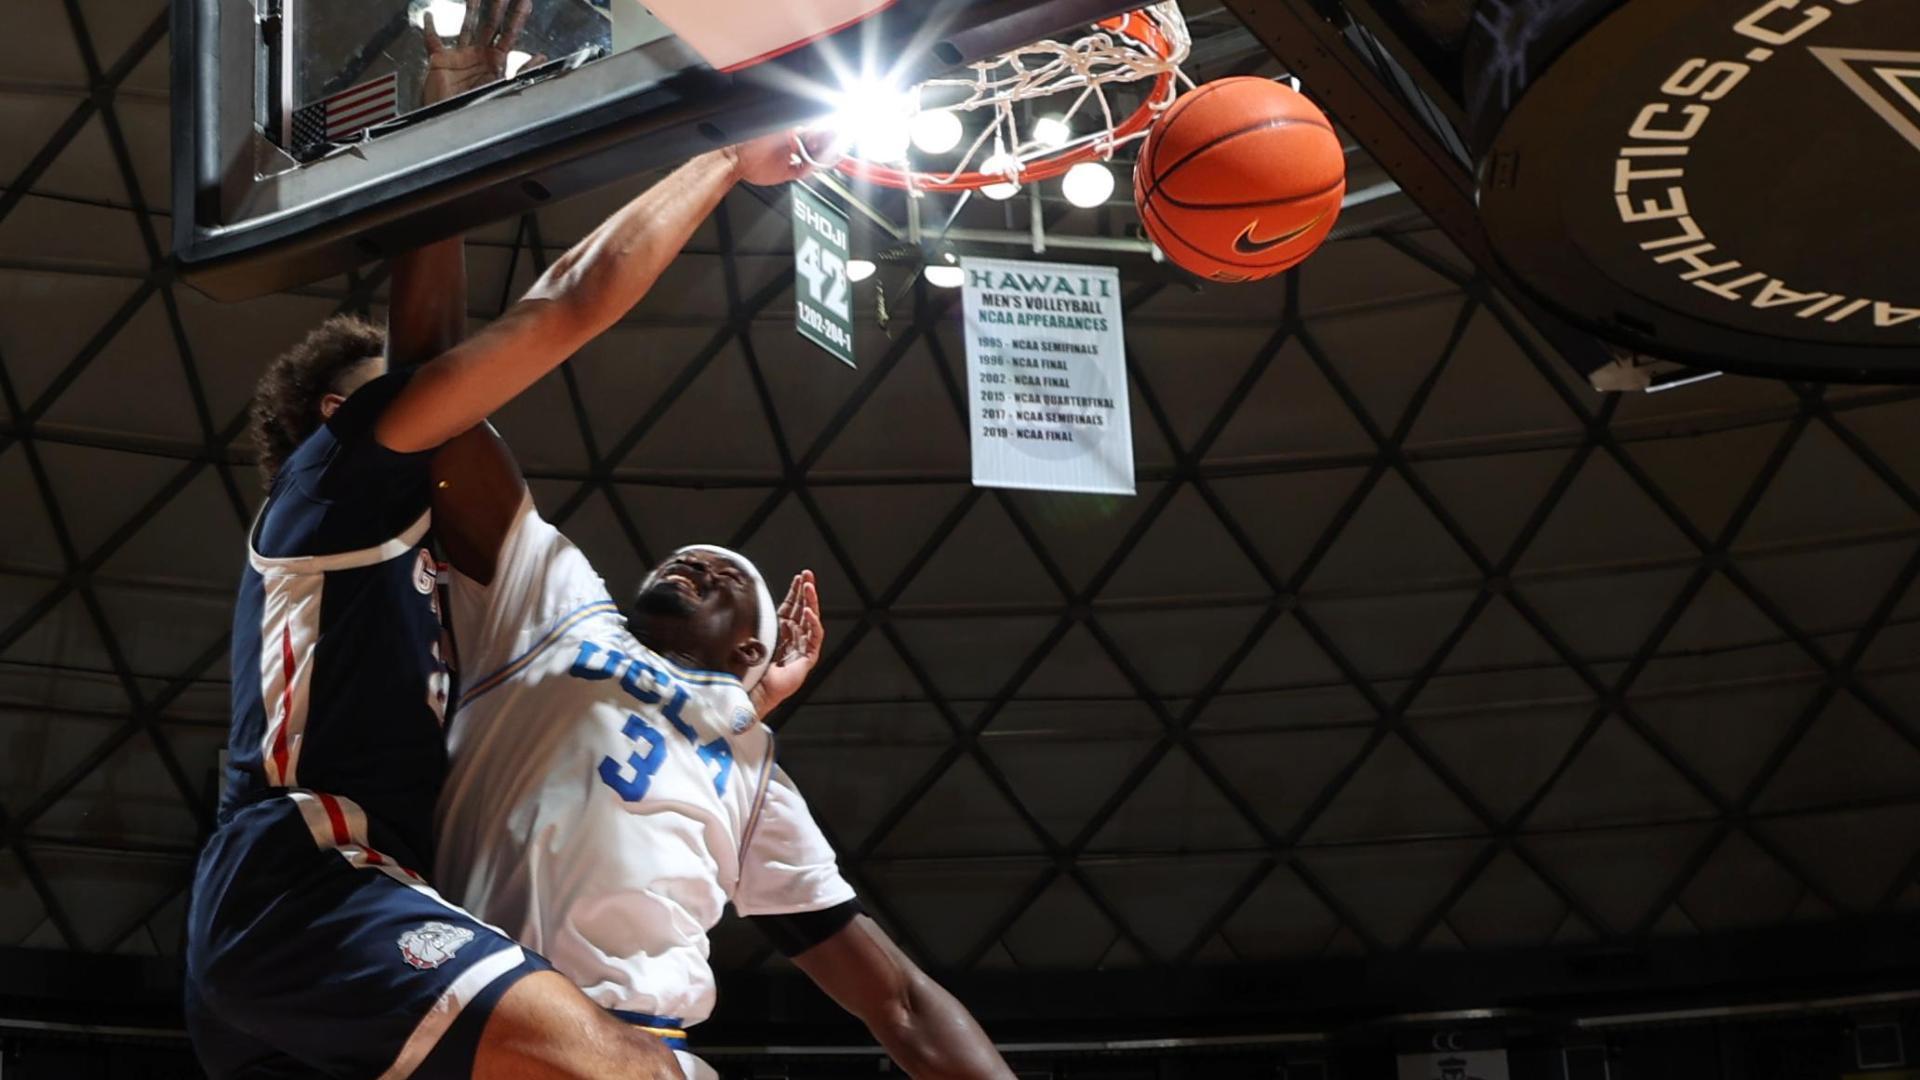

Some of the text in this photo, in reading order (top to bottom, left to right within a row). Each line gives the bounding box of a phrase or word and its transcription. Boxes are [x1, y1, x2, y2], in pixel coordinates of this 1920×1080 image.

[1615, 0, 1920, 326] AIIATHLETICS.C
[793, 198, 846, 250] SHOJI
[796, 235, 849, 323] 42
[981, 293, 1103, 315] MEN'S VOLLEYBALL
[979, 310, 1108, 332] NCAA APPEARANCES
[978, 337, 1003, 348] 1995
[1012, 339, 1038, 351] NCAA
[1041, 341, 1099, 355] SEMIFINALS
[1012, 357, 1039, 368] NCAA
[1041, 359, 1068, 371] FINAL
[980, 372, 1006, 384] 2002
[1014, 375, 1041, 386] NCAA
[1044, 377, 1070, 388] FINAL
[981, 390, 1005, 401] 2015
[1014, 392, 1042, 404] NCAA
[1044, 394, 1116, 409] QUARTERFINAL
[982, 408, 1006, 419] 2017
[1016, 411, 1043, 422] NCAA
[1045, 412, 1104, 426] SEMIFINALS
[1017, 429, 1043, 440] NCAA
[1046, 431, 1074, 442] FINAL
[570, 640, 733, 798] UCLA
[598, 714, 667, 802] 3
